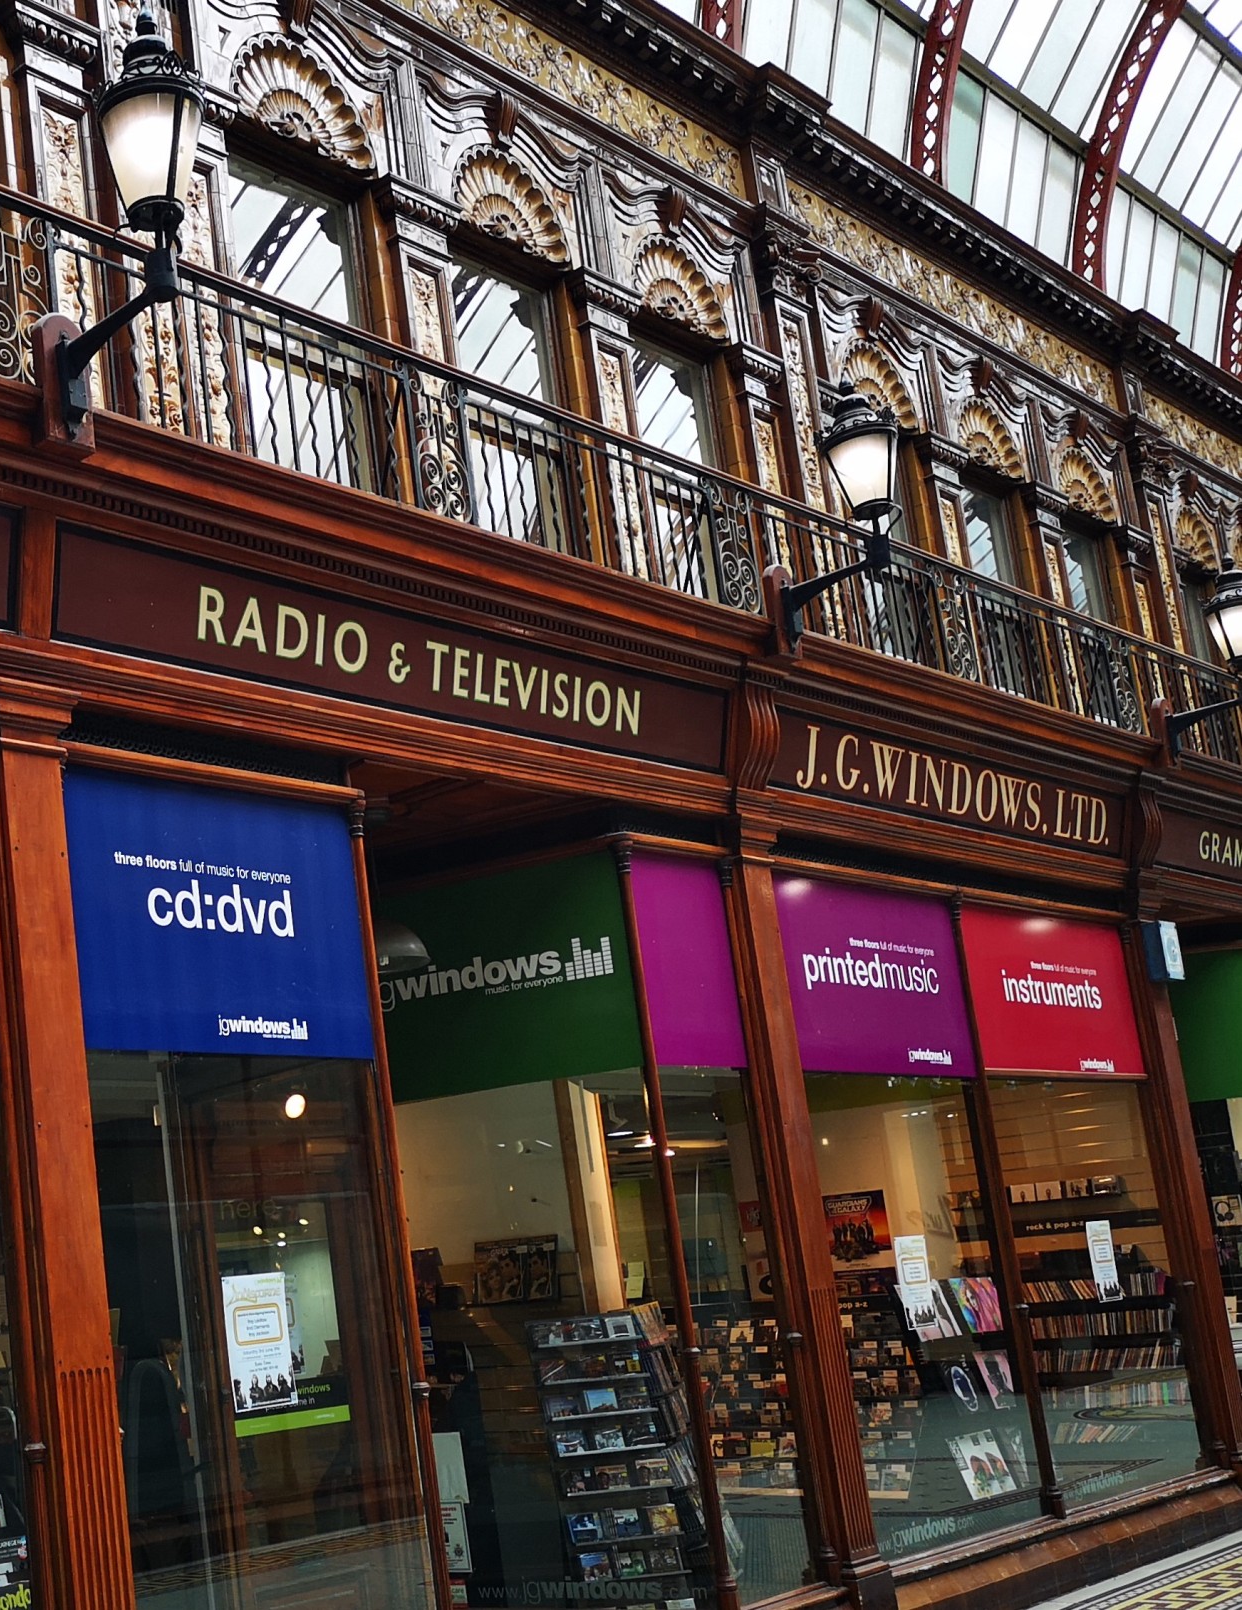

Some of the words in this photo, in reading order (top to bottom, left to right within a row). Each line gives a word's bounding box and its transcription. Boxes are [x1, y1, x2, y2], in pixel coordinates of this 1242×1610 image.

[197, 585, 368, 673] RADIO
[388, 642, 411, 684] &
[426, 640, 641, 736] TELEVISION
[114, 851, 143, 867] three
[145, 855, 177, 871] floors
[179, 859, 193, 873] full
[195, 861, 205, 874] of
[206, 864, 234, 878] music
[236, 866, 249, 879] for
[251, 870, 291, 884] everyone
[147, 879, 294, 937] cd:dvd
[484, 984, 510, 996] music
[511, 981, 523, 991] for
[524, 975, 564, 989] everyone
[802, 947, 939, 994] printedmusic
[1001, 969, 1102, 1010] instruments
[218, 1014, 290, 1036] jgwindows
[1026, 1223, 1045, 1231] rock
[1054, 1221, 1070, 1230] pop
[478, 1576, 709, 1602] www.jgwindows.com
